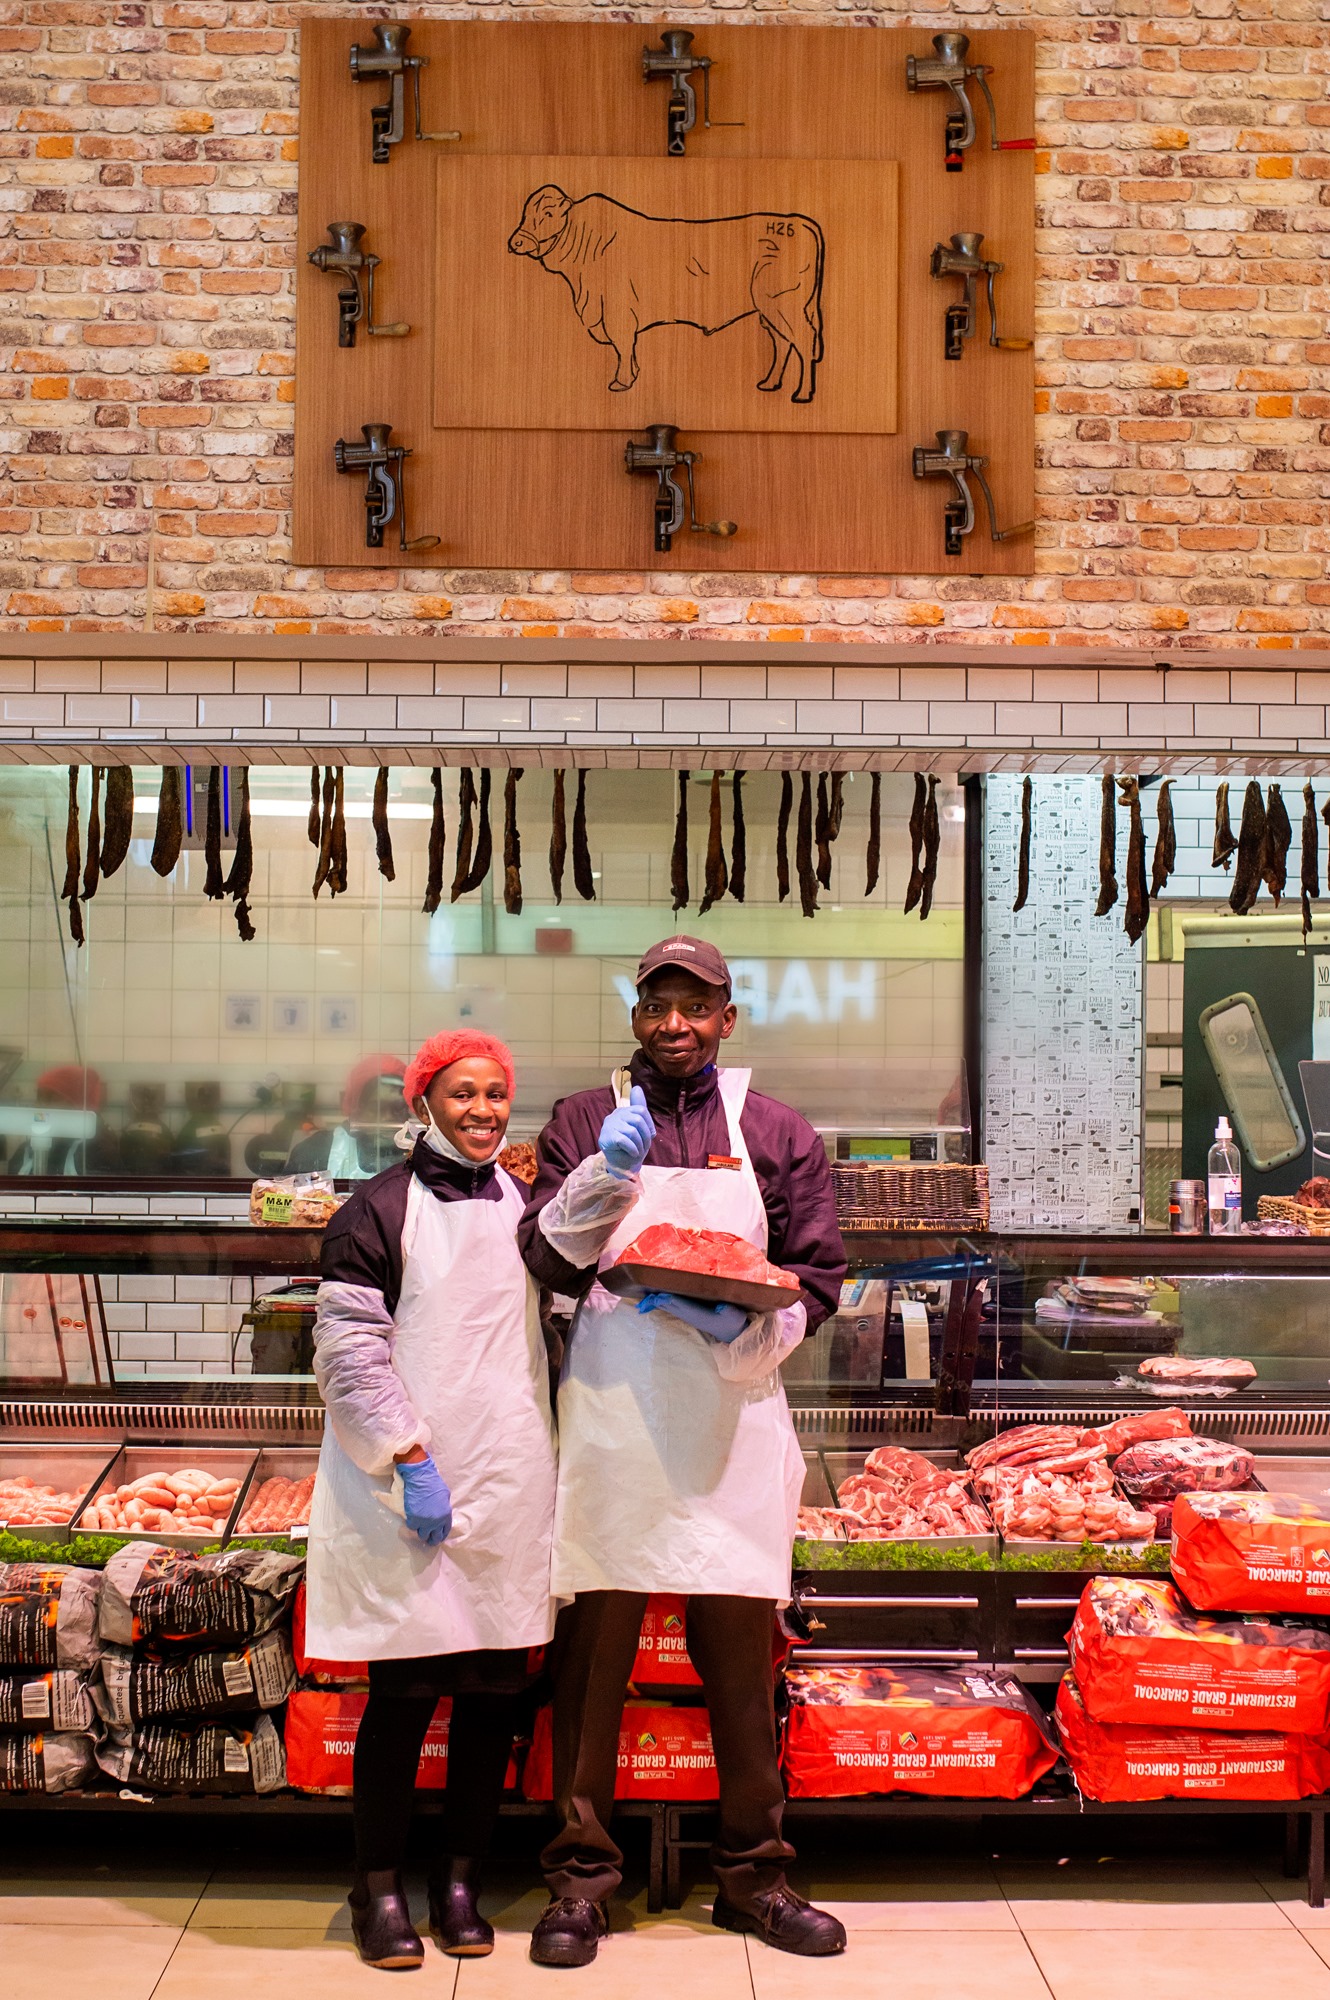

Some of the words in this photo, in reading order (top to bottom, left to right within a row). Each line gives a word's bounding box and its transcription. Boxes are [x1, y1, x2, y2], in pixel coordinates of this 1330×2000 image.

[766, 222, 794, 237] H26
[1247, 1567, 1303, 1583] CHARCOAL
[1306, 1571, 1330, 1584] RADE
[1134, 1684, 1189, 1702] CHARCOAL
[1191, 1690, 1227, 1705] GRADE
[1230, 1692, 1297, 1708] RESTAURANT
[116, 1687, 124, 1720] quettes
[631, 1755, 666, 1768] GRADE
[669, 1755, 715, 1768] TAURANT
[833, 1753, 889, 1766] CHARCOAL
[892, 1754, 927, 1767] GRADE
[928, 1753, 996, 1768] RESTAURANT
[1220, 1759, 1285, 1775] RESTAURANT
[1125, 1761, 1179, 1777] CHARCOAL
[1183, 1762, 1217, 1775] GRADE
